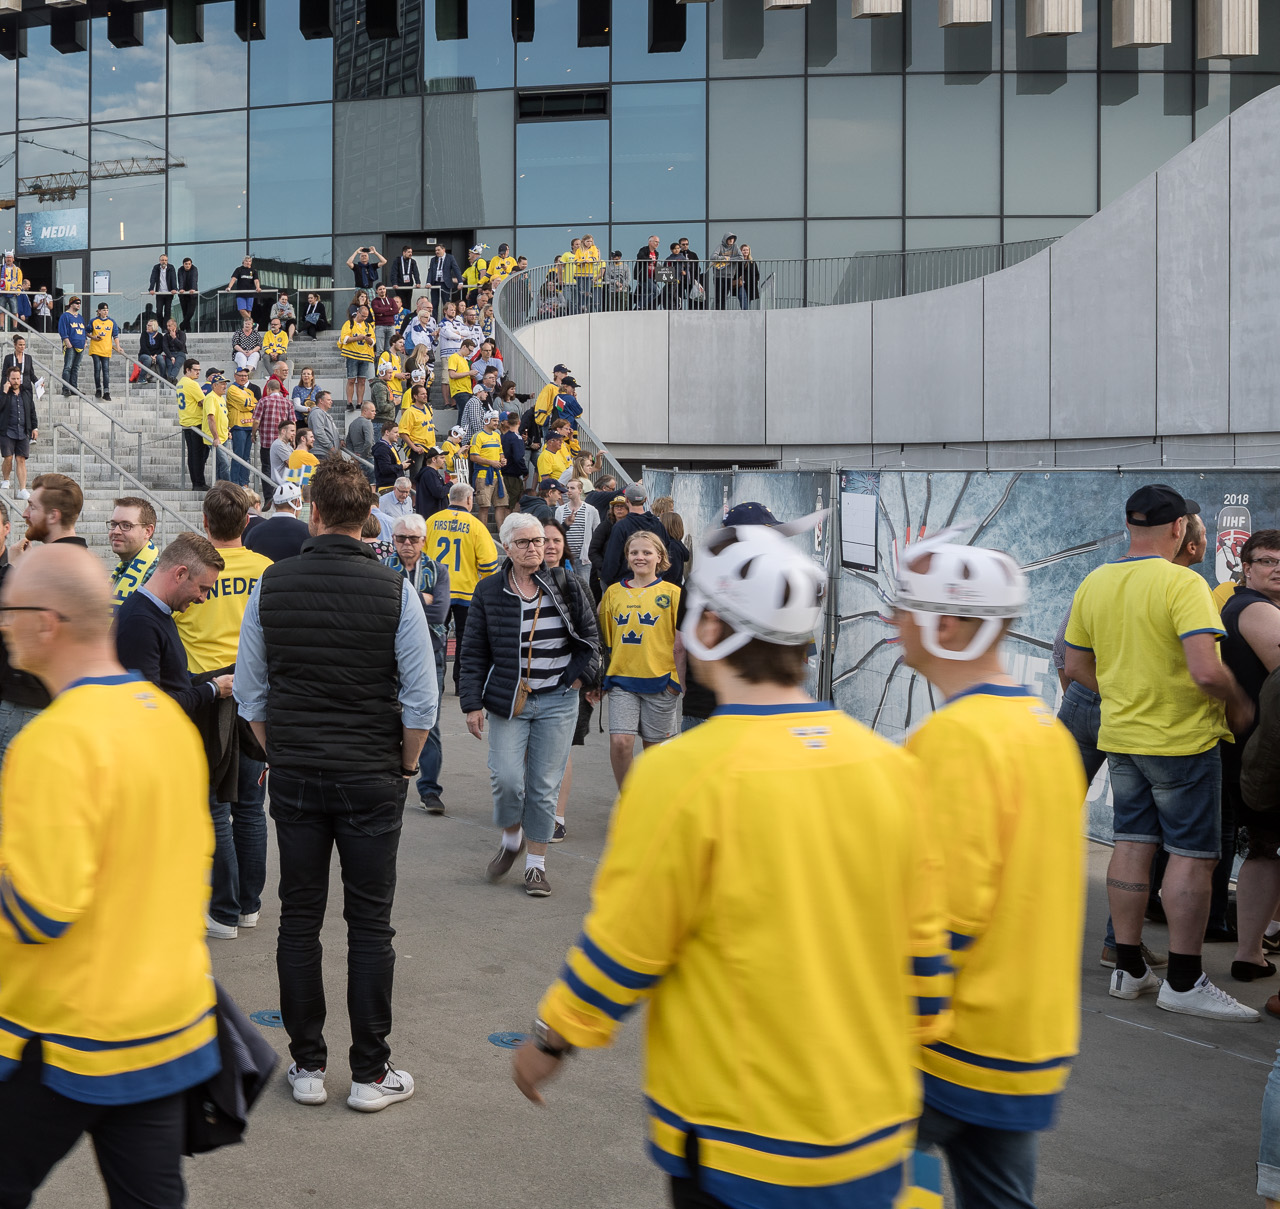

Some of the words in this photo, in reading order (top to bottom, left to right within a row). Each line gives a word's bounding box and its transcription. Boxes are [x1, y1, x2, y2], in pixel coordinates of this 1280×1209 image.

[41, 225, 77, 239] MEDIA
[1223, 494, 1249, 505] 2018
[1222, 516, 1246, 528] IIHF
[436, 537, 462, 572] 21
